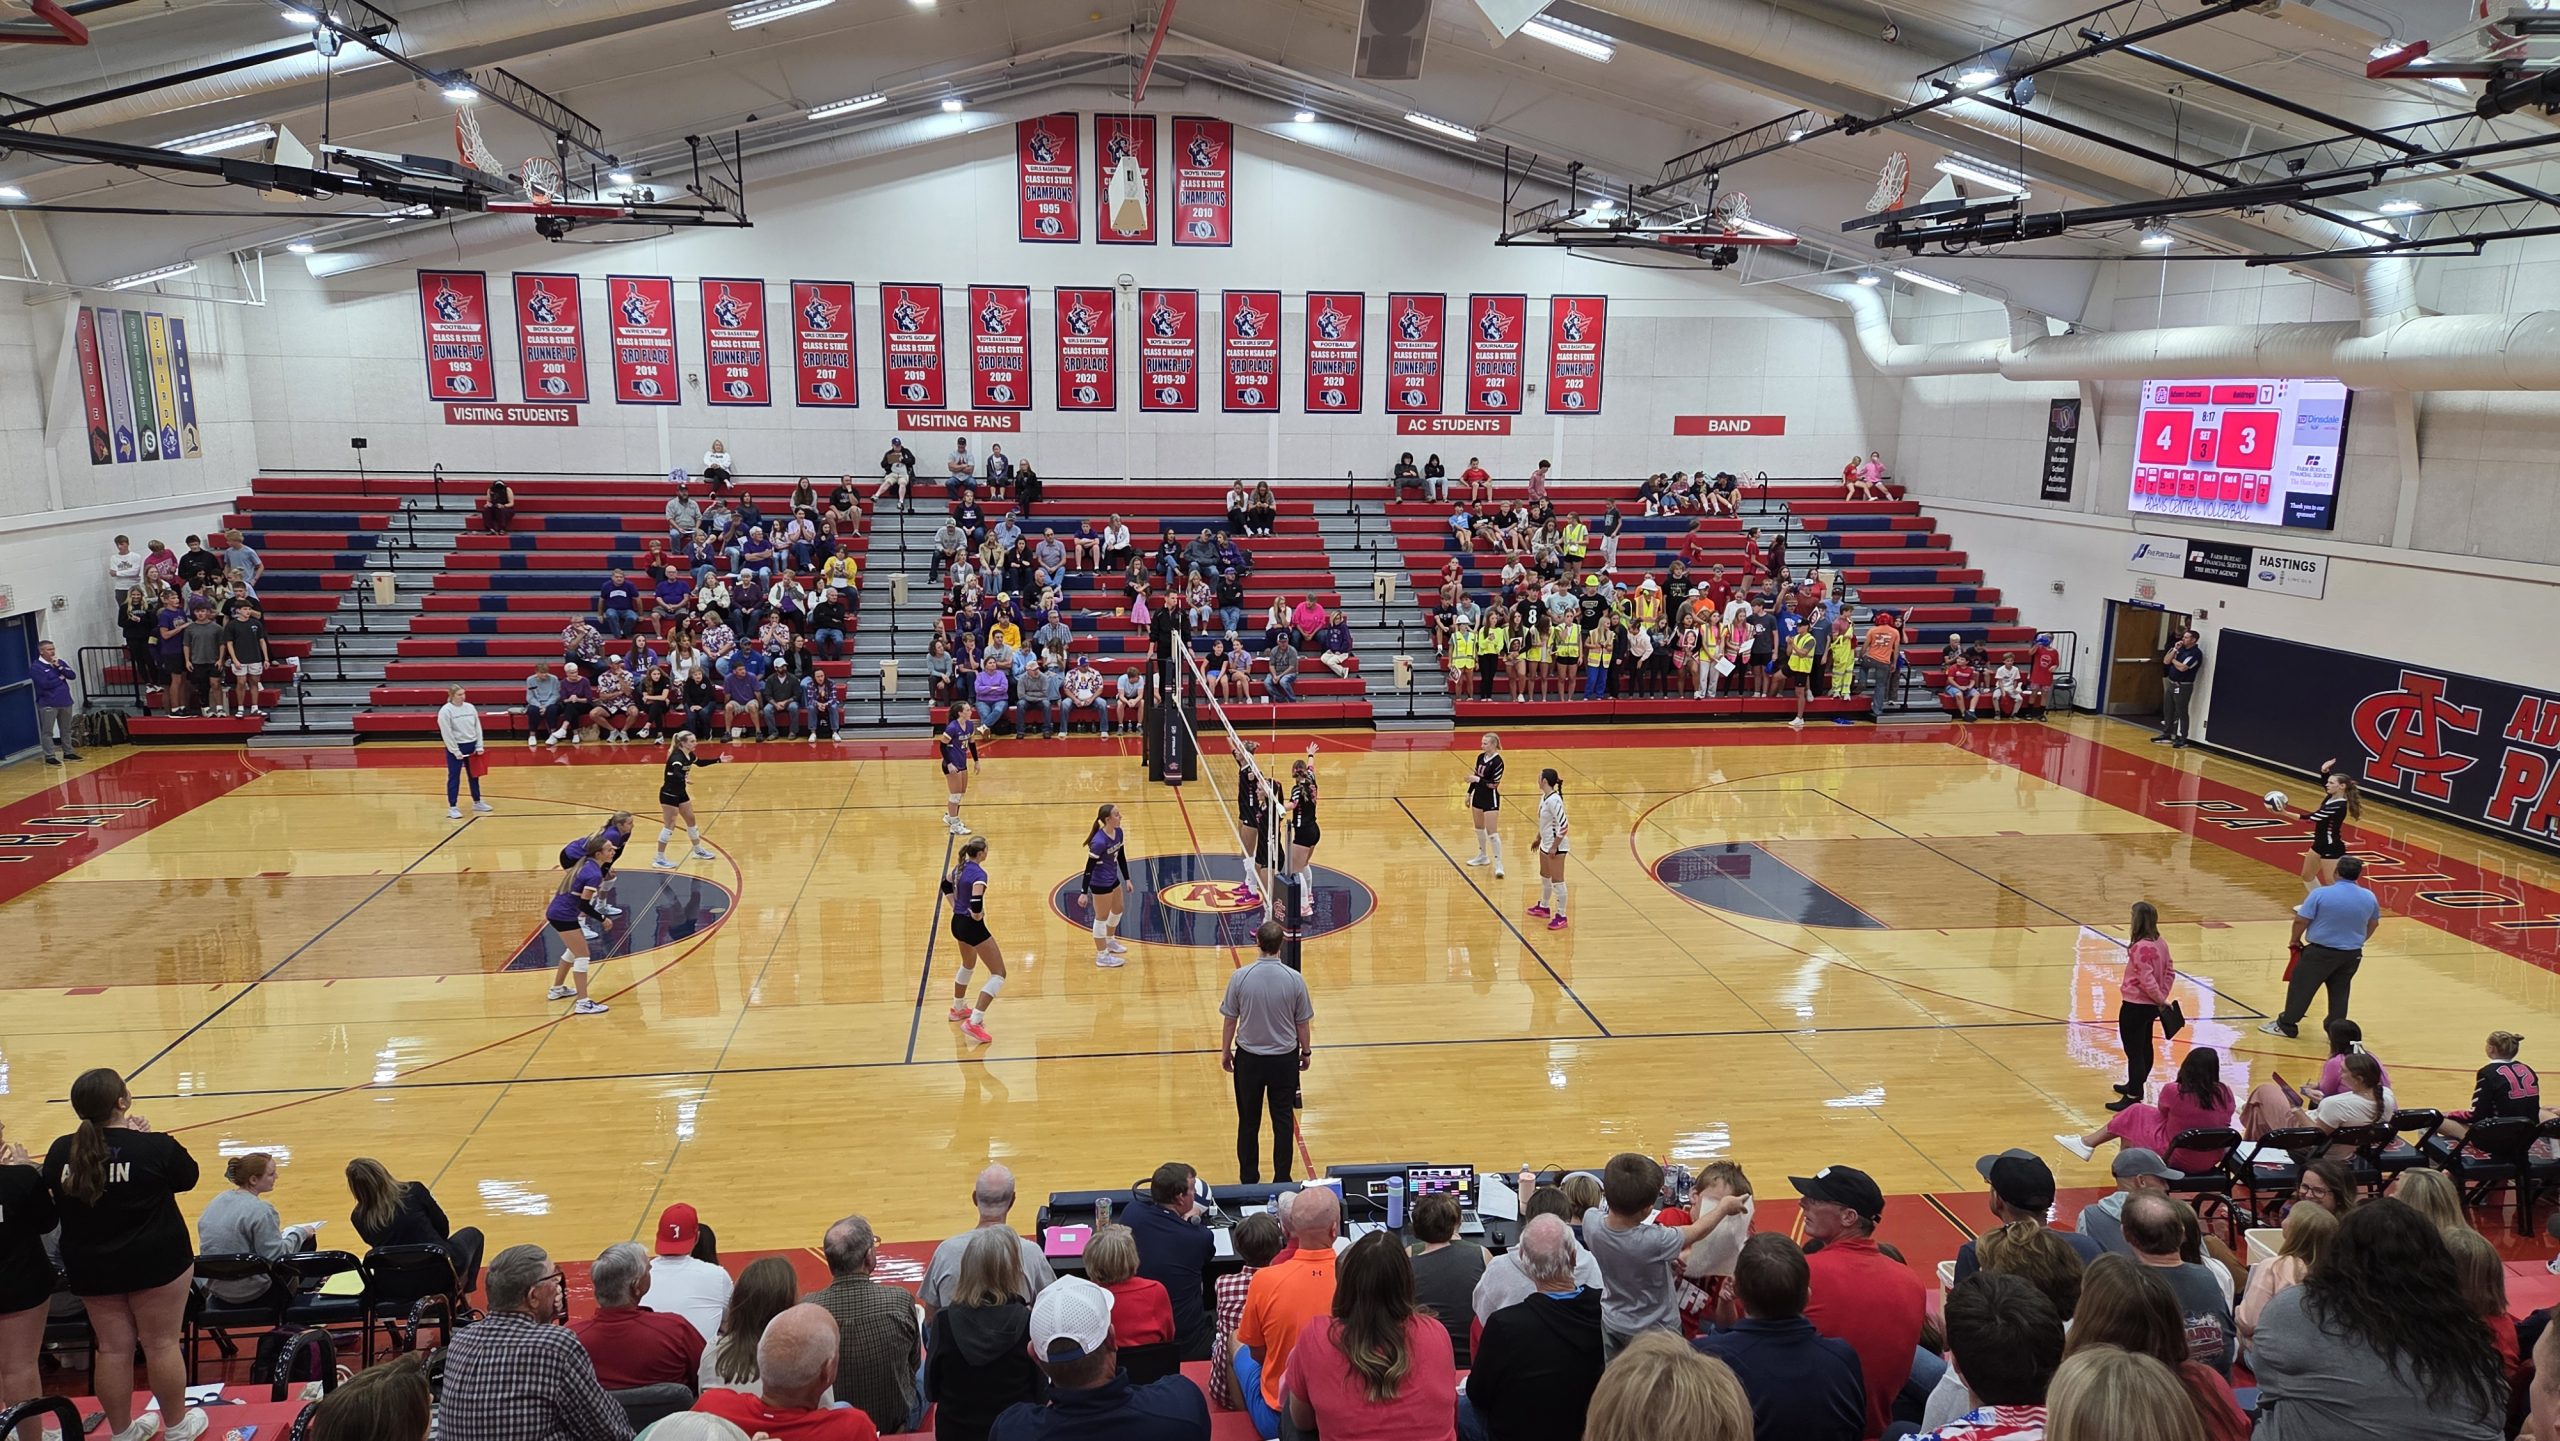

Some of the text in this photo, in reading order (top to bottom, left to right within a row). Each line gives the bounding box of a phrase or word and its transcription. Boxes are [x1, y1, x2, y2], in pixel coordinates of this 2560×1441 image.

[1025, 175, 1072, 184] CLASS C1 STATE
[1181, 180, 1224, 188] CLASS B STATE
[1026, 186, 1073, 203] CHAMPIONS
[1180, 190, 1226, 208] CHAMPIONS
[1038, 204, 1060, 214] 1995
[1192, 208, 1213, 217] 2010
[433, 334, 455, 342] CLASS
[456, 334, 461, 342] B
[711, 340, 731, 348] CLASS
[802, 342, 823, 350] CLASS
[824, 342, 828, 350] C
[891, 344, 911, 352] CLASS
[912, 344, 916, 352] B
[433, 344, 483, 361] RUNNER-UP
[527, 346, 576, 363] RUNNER-UP
[997, 346, 1005, 354] C1
[1006, 346, 1023, 354] STATE
[1063, 347, 1082, 355] CLASS
[1083, 347, 1091, 355] C1
[1330, 351, 1340, 359] C-1
[1341, 351, 1357, 359] STATE
[622, 348, 669, 365] 3RD PLACE
[712, 350, 761, 366] RUNNER-UP
[803, 352, 849, 368] 3RD PLACE
[1476, 352, 1516, 360] CLASS B STATE
[449, 362, 472, 372] 1993
[890, 354, 937, 370] RUNNER-UP
[979, 355, 1023, 372] 3RD PLACE
[1064, 356, 1108, 372] 3RD PLACE
[1147, 358, 1192, 374] RUNNER-UP
[1231, 359, 1272, 374] 3RD PLACE
[543, 364, 565, 373] 2001
[636, 365, 657, 376] 2014
[726, 368, 748, 377] 2016
[1312, 360, 1356, 376] RUNNER-UP
[1393, 361, 1437, 376] RUNNER-UP
[1475, 361, 1516, 376] 3RD PLACE
[1556, 363, 1594, 378] RUNNER-UP
[817, 369, 836, 379] 2017
[904, 371, 925, 380] 2019
[990, 372, 1012, 382] 2020
[1075, 373, 1097, 383] 2020
[1152, 375, 1186, 384] 2019-20
[1235, 375, 1268, 385] 2019-20
[1324, 376, 1344, 386] 2020
[1405, 377, 1424, 386] 2021
[1486, 378, 1504, 387] 2021
[1565, 379, 1584, 388] 2023
[453, 407, 569, 422] VISITING STUDENTS
[2202, 411, 2215, 422] 8:17
[2308, 415, 2339, 423] Dinsdale
[907, 414, 1011, 428] VISITING FANS
[1408, 419, 1500, 430] AC STUDENTS
[1709, 420, 1751, 432] BAND
[2156, 424, 2172, 450] 4
[2239, 427, 2256, 454] 3
[2200, 443, 2207, 458] 3
[2169, 498, 2201, 515] CENTRAL
[2203, 501, 2250, 520] VOLLEYBALL
[2260, 555, 2316, 572] HASTINGS
[2219, 569, 2239, 577] AGENCY
[1527, 609, 1537, 624] 8
[2496, 1064, 2539, 1099] 12
[61, 1162, 130, 1184] AIN
